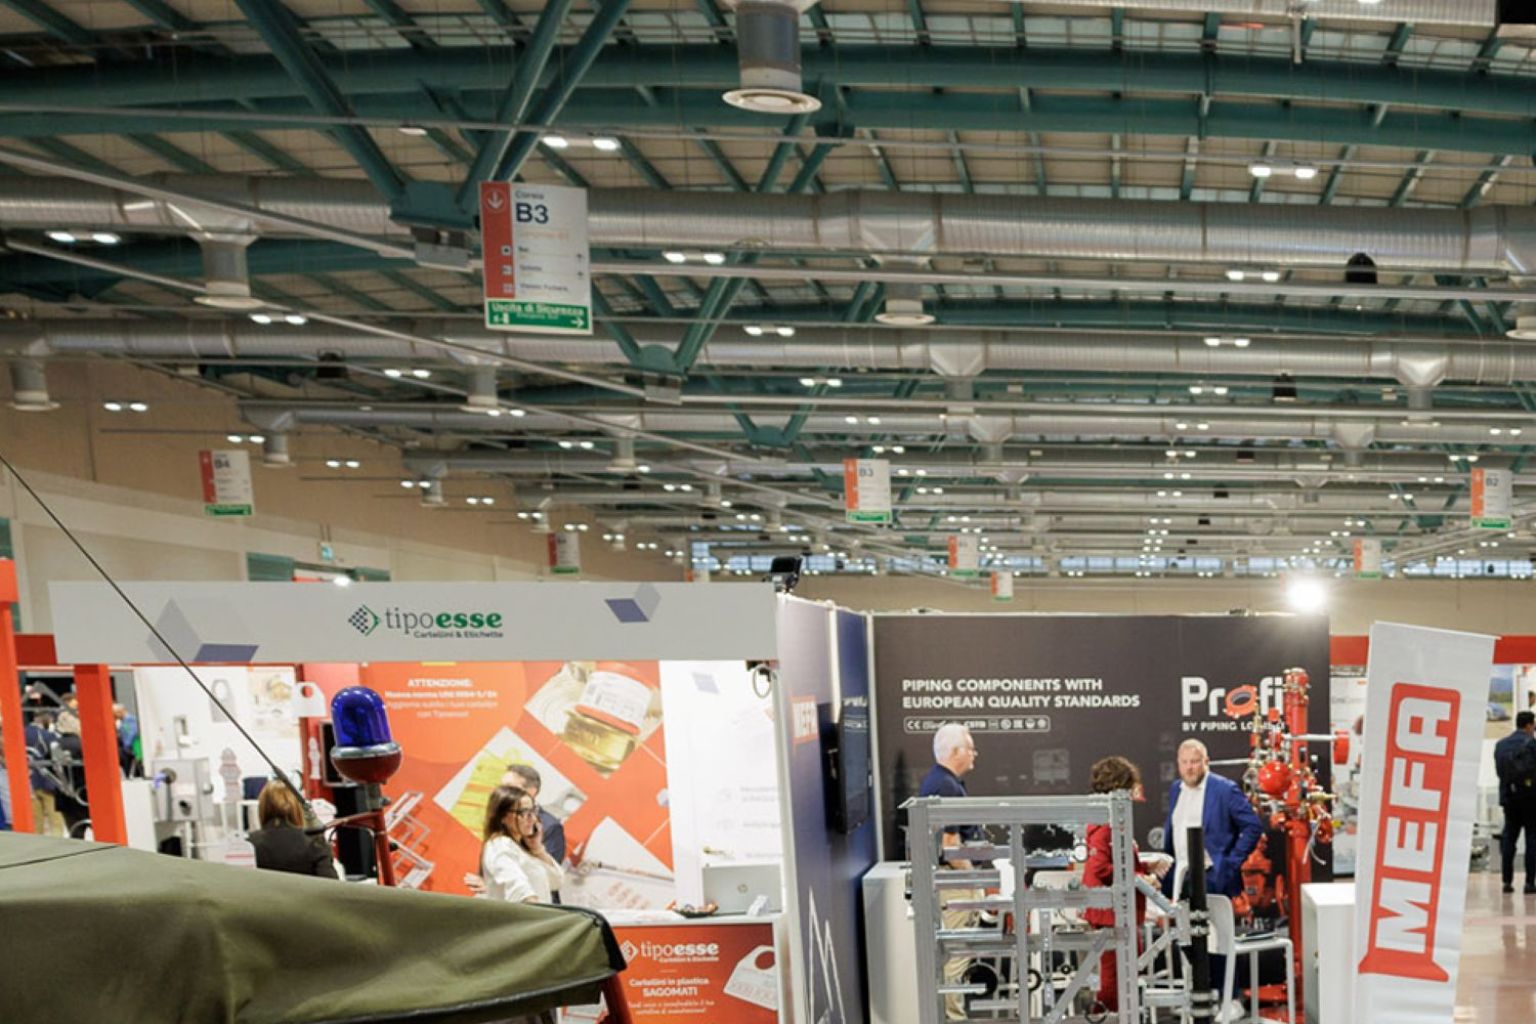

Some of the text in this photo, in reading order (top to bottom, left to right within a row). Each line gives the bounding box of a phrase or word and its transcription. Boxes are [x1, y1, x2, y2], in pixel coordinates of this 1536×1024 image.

[515, 202, 549, 224] B3
[491, 302, 522, 313] Uscita
[525, 303, 534, 314] di
[536, 303, 585, 317] Sicurezza
[385, 607, 503, 634] tipoesse
[902, 678, 1102, 691] PIPING COMPONENTS WITH
[902, 695, 1141, 709] EUROPEAN QUALITY STANDARDS
[1182, 721, 1197, 731] BY
[1200, 721, 1237, 731] PIPING
[1375, 696, 1452, 954] MEFA
[640, 941, 720, 960] tipoesse
[629, 979, 667, 988] Cartellini
[677, 977, 709, 987] plastica
[642, 987, 698, 997] SAGOMATI
